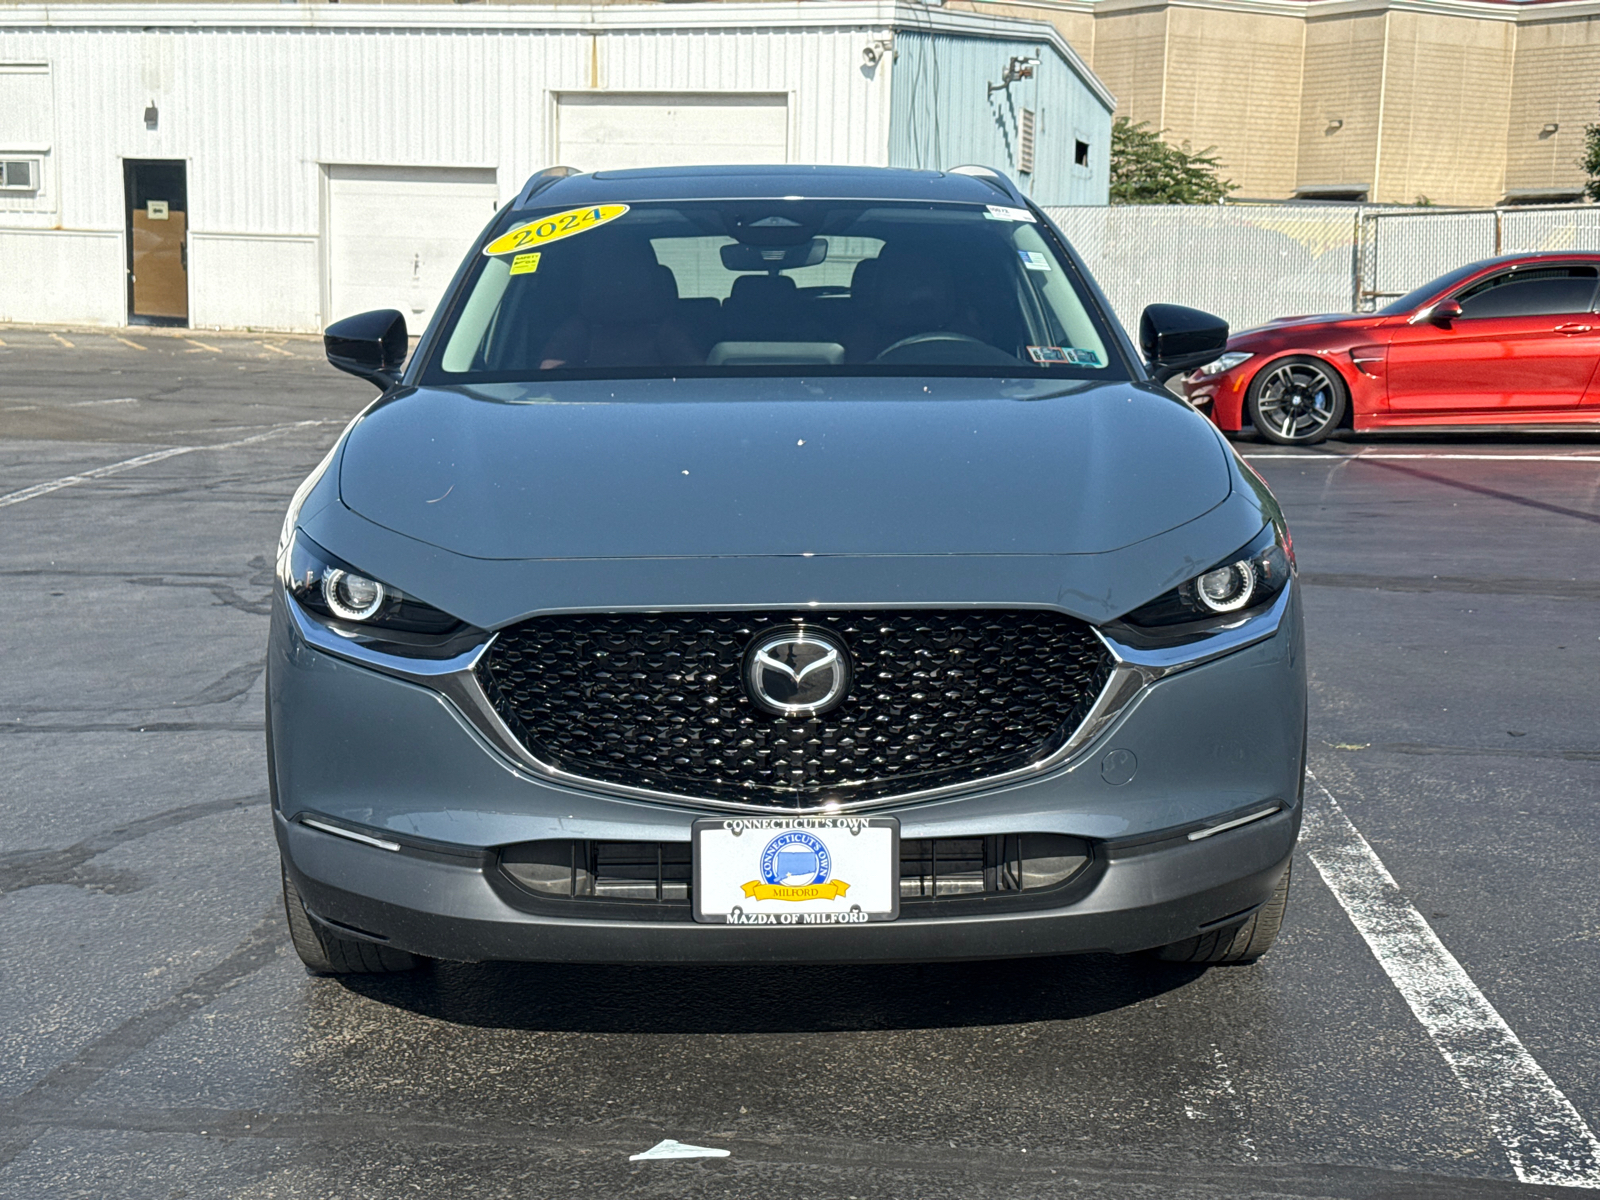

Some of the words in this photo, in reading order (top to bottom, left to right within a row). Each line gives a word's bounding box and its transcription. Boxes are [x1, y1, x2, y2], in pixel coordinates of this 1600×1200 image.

[513, 208, 606, 248] 2024
[723, 818, 833, 830] CONNECTICUT'S
[836, 818, 870, 829] OWN
[763, 833, 822, 878] CONNECTICUT'S
[818, 850, 829, 877] OWN
[773, 888, 819, 897] MILFORD
[726, 913, 777, 925] MAZDA
[780, 913, 800, 924] OF
[803, 912, 869, 924] MILFORD
